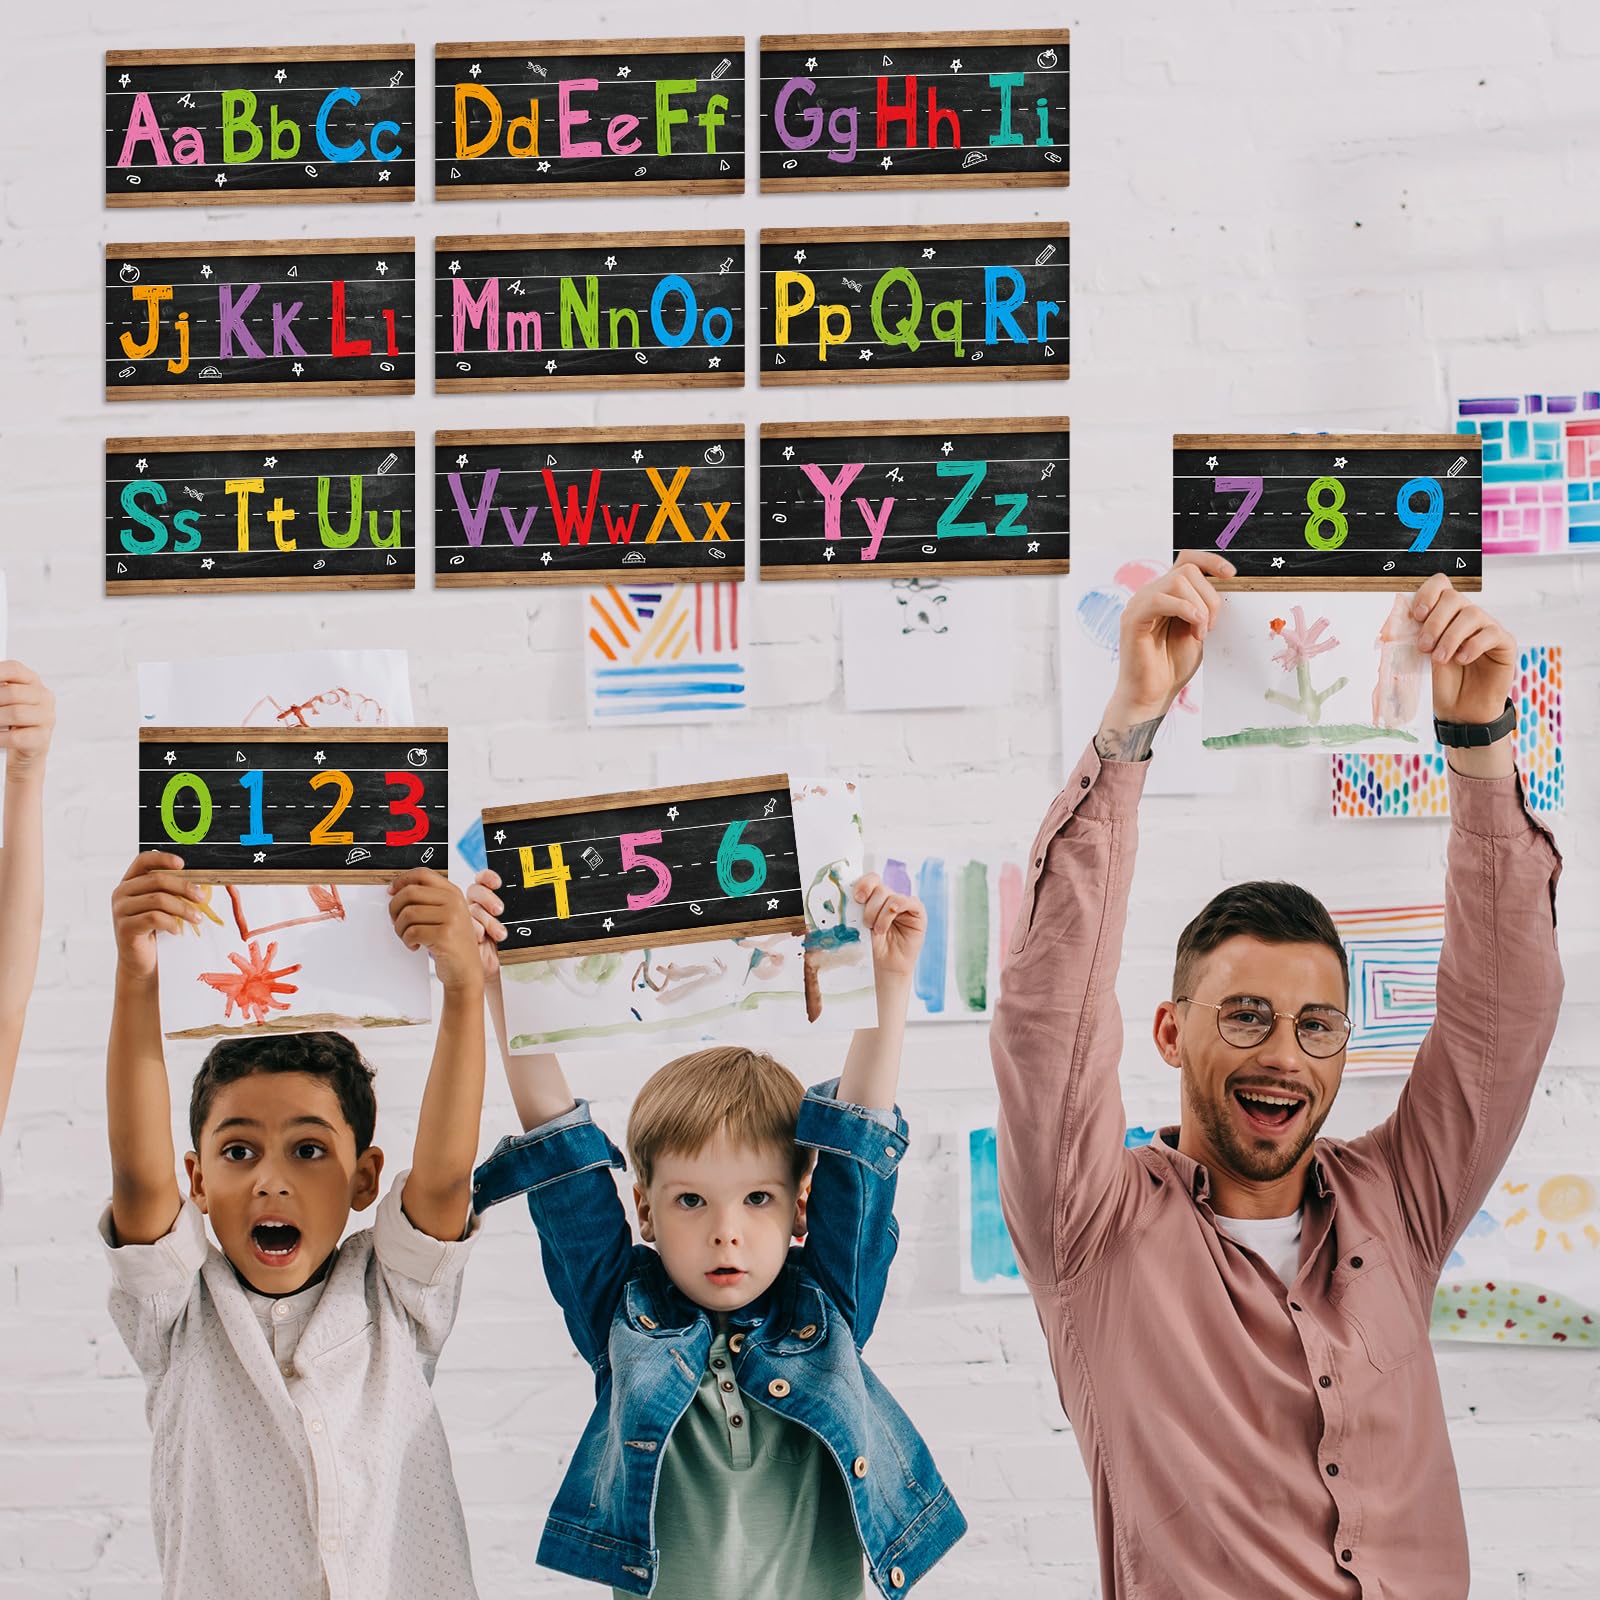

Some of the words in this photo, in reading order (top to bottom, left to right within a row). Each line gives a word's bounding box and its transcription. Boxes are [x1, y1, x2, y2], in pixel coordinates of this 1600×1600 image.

[116, 93, 205, 167] Aa
[221, 88, 301, 165] Bb
[315, 86, 403, 164] Cc
[453, 82, 540, 161] Dd
[558, 77, 641, 159] Ee
[655, 78, 729, 157] Ff
[775, 78, 857, 162] Gg
[875, 74, 961, 150] Hh
[988, 71, 1054, 148] Ii
[119, 284, 191, 375] Jj
[452, 278, 543, 353] Mm
[559, 275, 641, 350] Nn
[650, 273, 733, 349] Oo
[775, 270, 852, 362] Pp
[870, 266, 966, 358] Qq
[983, 264, 1060, 346] Rr
[120, 479, 202, 556] Ss
[224, 477, 297, 554] Tt
[317, 474, 402, 550] Uu
[448, 470, 535, 546] Vv
[540, 467, 641, 547] Ww
[643, 465, 732, 545] Xx
[800, 463, 895, 561] Yy
[935, 460, 1029, 539] Zz
[1215, 477, 1262, 548] 7
[1304, 475, 1349, 551] 8
[1396, 475, 1445, 553] 9
[160, 772, 213, 845] 0
[238, 769, 274, 847] 1
[308, 769, 355, 846] 2
[384, 771, 430, 847] 3
[517, 843, 572, 920] 4
[619, 829, 673, 911] 5
[716, 819, 767, 898] 6
